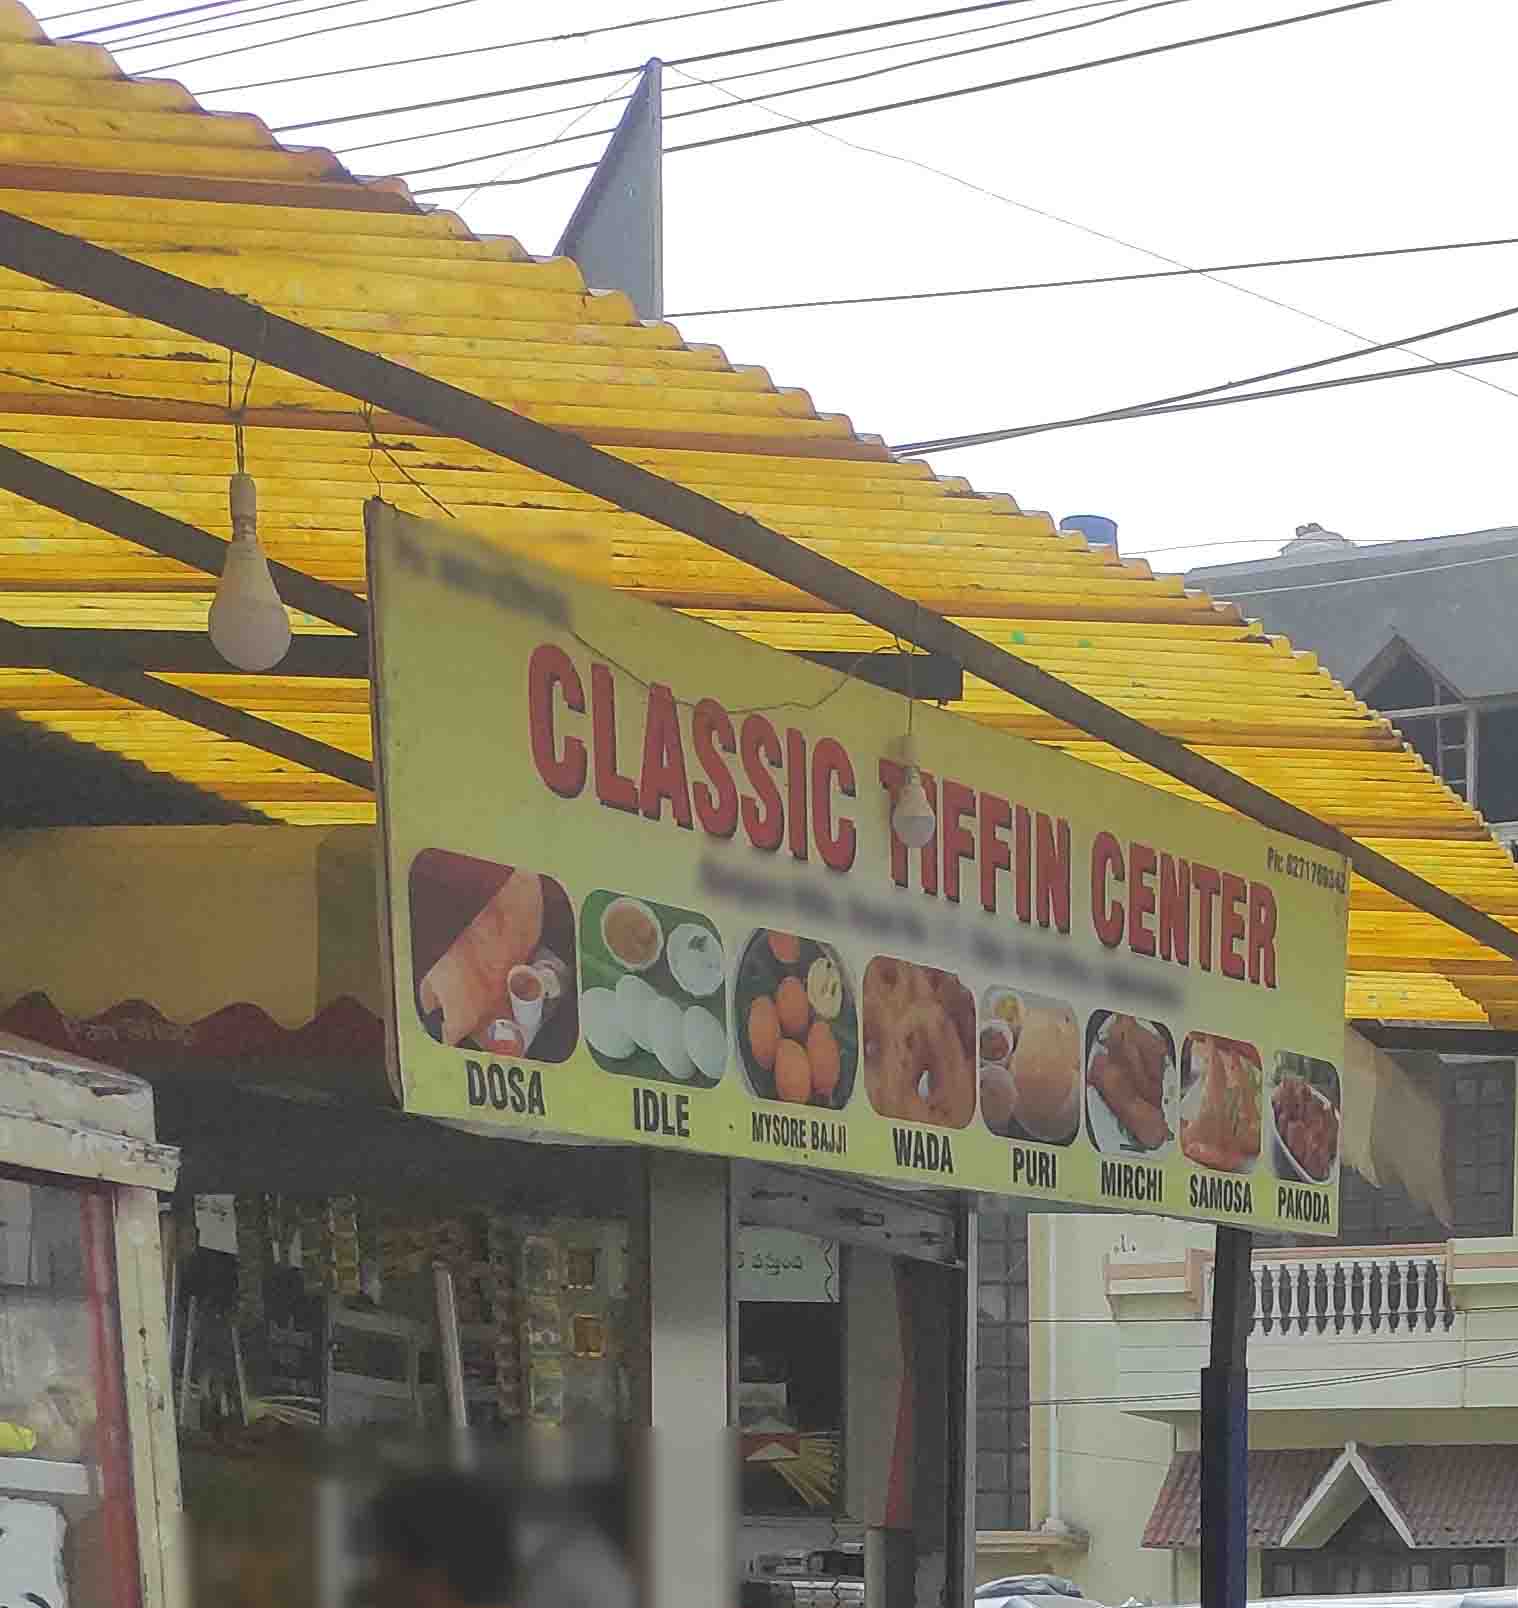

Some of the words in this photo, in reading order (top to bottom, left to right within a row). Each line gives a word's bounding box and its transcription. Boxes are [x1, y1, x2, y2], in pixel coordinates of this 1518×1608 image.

[528, 644, 858, 873] CLASSIC
[878, 758, 1071, 936] TIFFIN
[1091, 831, 1278, 990] CENTER
[466, 1061, 547, 1118] DOSA
[633, 1087, 691, 1139] IDLE
[751, 1111, 808, 1150] MYSORE
[811, 1117, 849, 1154] BAJJI
[892, 1127, 954, 1175] WADA
[1012, 1147, 1057, 1190] PURI
[1100, 1160, 1163, 1204] MIRCHI
[1189, 1174, 1253, 1215] SAMOSA
[1277, 1185, 1331, 1226] PAKODA
